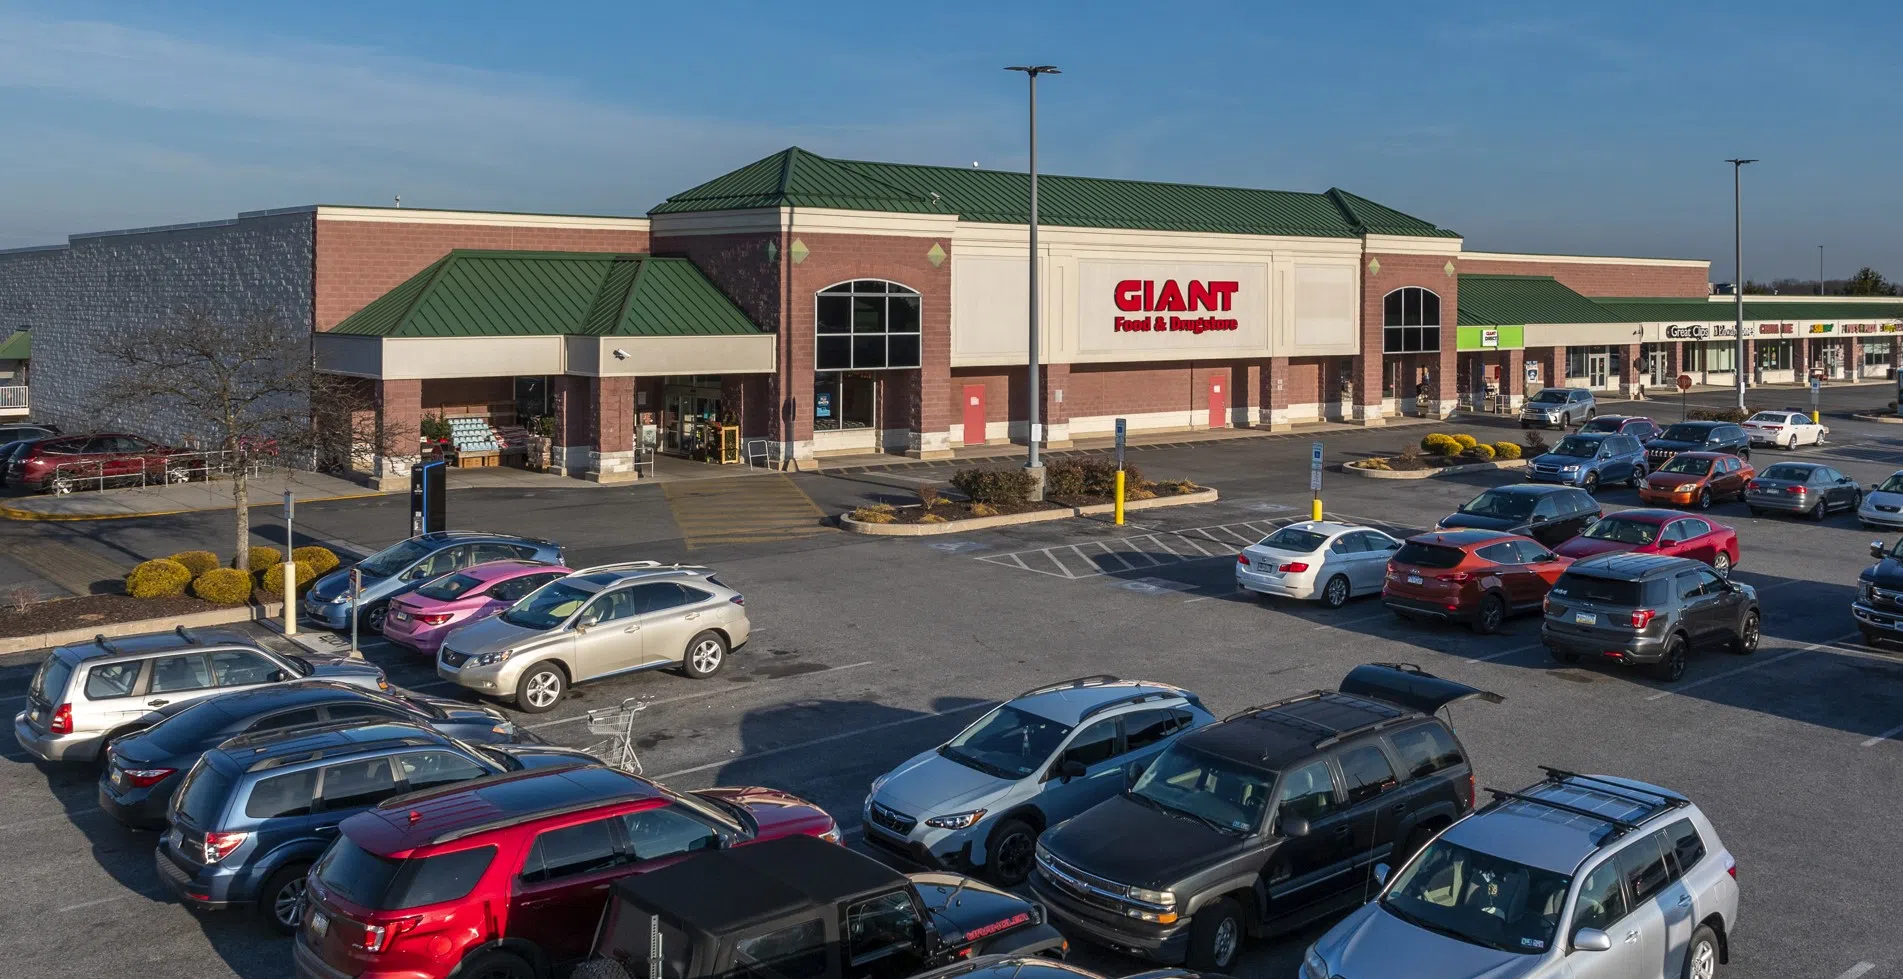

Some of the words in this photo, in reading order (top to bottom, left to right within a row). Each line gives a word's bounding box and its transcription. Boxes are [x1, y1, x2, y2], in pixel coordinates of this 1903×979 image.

[1114, 279, 1239, 312] GIANT
[1114, 316, 1152, 332] Food
[1154, 316, 1167, 332] &
[1169, 316, 1239, 334] Drugstore
[1671, 325, 1691, 337] Great
[1692, 325, 1709, 339] Clips
[966, 912, 1029, 940] WRANGLER
